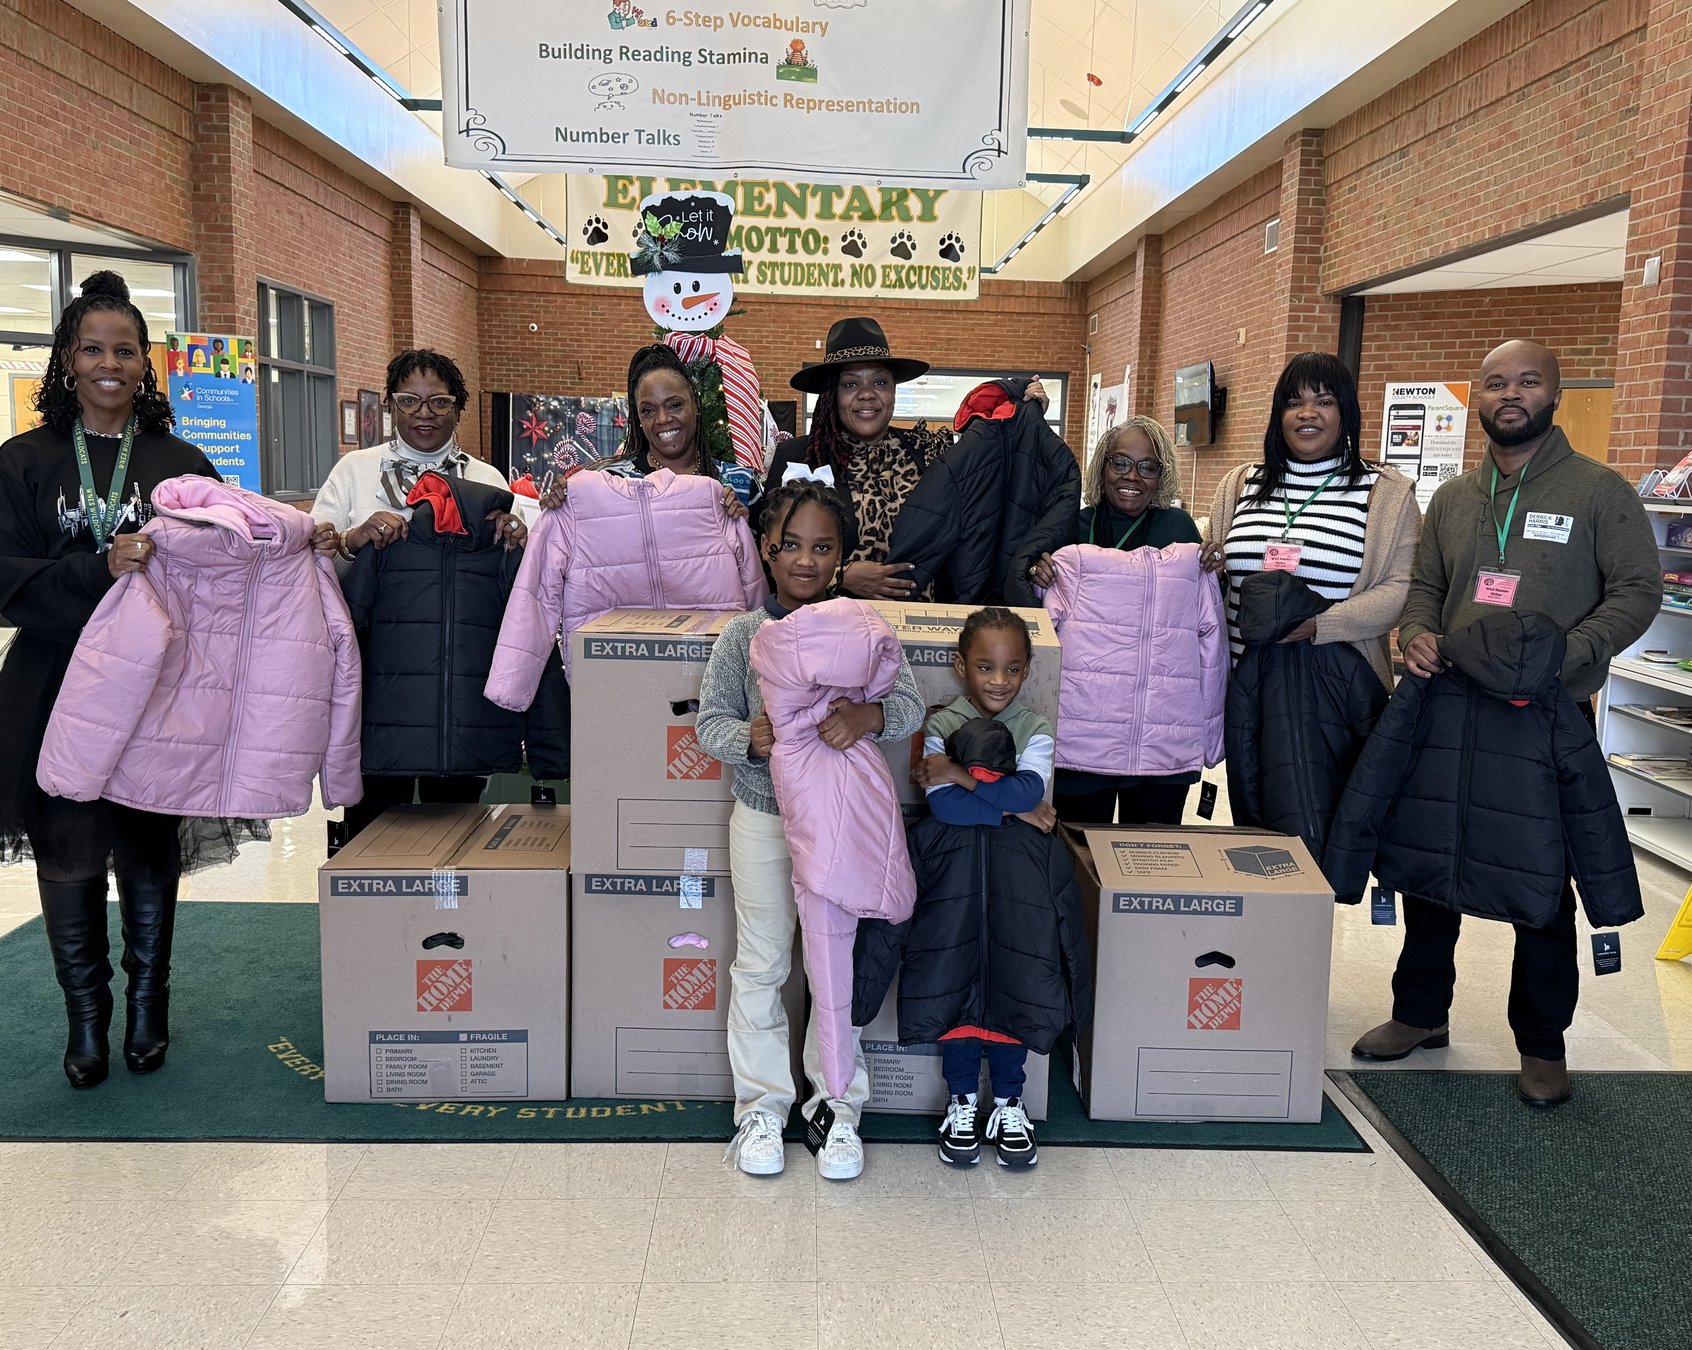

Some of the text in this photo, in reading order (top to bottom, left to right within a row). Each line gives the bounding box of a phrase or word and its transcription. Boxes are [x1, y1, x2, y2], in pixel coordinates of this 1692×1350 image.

[665, 9, 724, 32] 6-Step
[729, 12, 829, 37] Vocabulary
[538, 43, 769, 67] Building Reading Stamina
[651, 88, 920, 114] Non-Linguistic Representation
[555, 126, 630, 144] Number
[634, 129, 681, 147] Talks
[682, 208, 714, 222] Let it
[726, 224, 830, 256] MOTTO:
[570, 248, 632, 279] “EVER
[850, 264, 876, 289] NO
[196, 387, 239, 396] Communities
[1392, 388, 1436, 396] NEWTON
[182, 416, 226, 428] Bringing
[182, 430, 252, 440] Communities
[196, 443, 240, 455] Support
[591, 642, 713, 658] EXTRA LARGE
[672, 732, 695, 753] THE
[1266, 862, 1296, 871] EXTRA
[1268, 866, 1298, 876] LARGE
[337, 880, 396, 893] EXTRA
[591, 878, 647, 892] EXTRA
[1119, 896, 1236, 912] EXTRA LARGE
[417, 960, 472, 1010] HOME
[422, 965, 445, 986] THE
[663, 959, 716, 1009] HOME
[669, 964, 691, 985] THE
[438, 978, 472, 1011] DEPOT
[684, 978, 716, 1010] DEPOT
[1188, 979, 1242, 1029] HOME
[1194, 984, 1216, 1004] THE
[1208, 997, 1241, 1030] DEPOT
